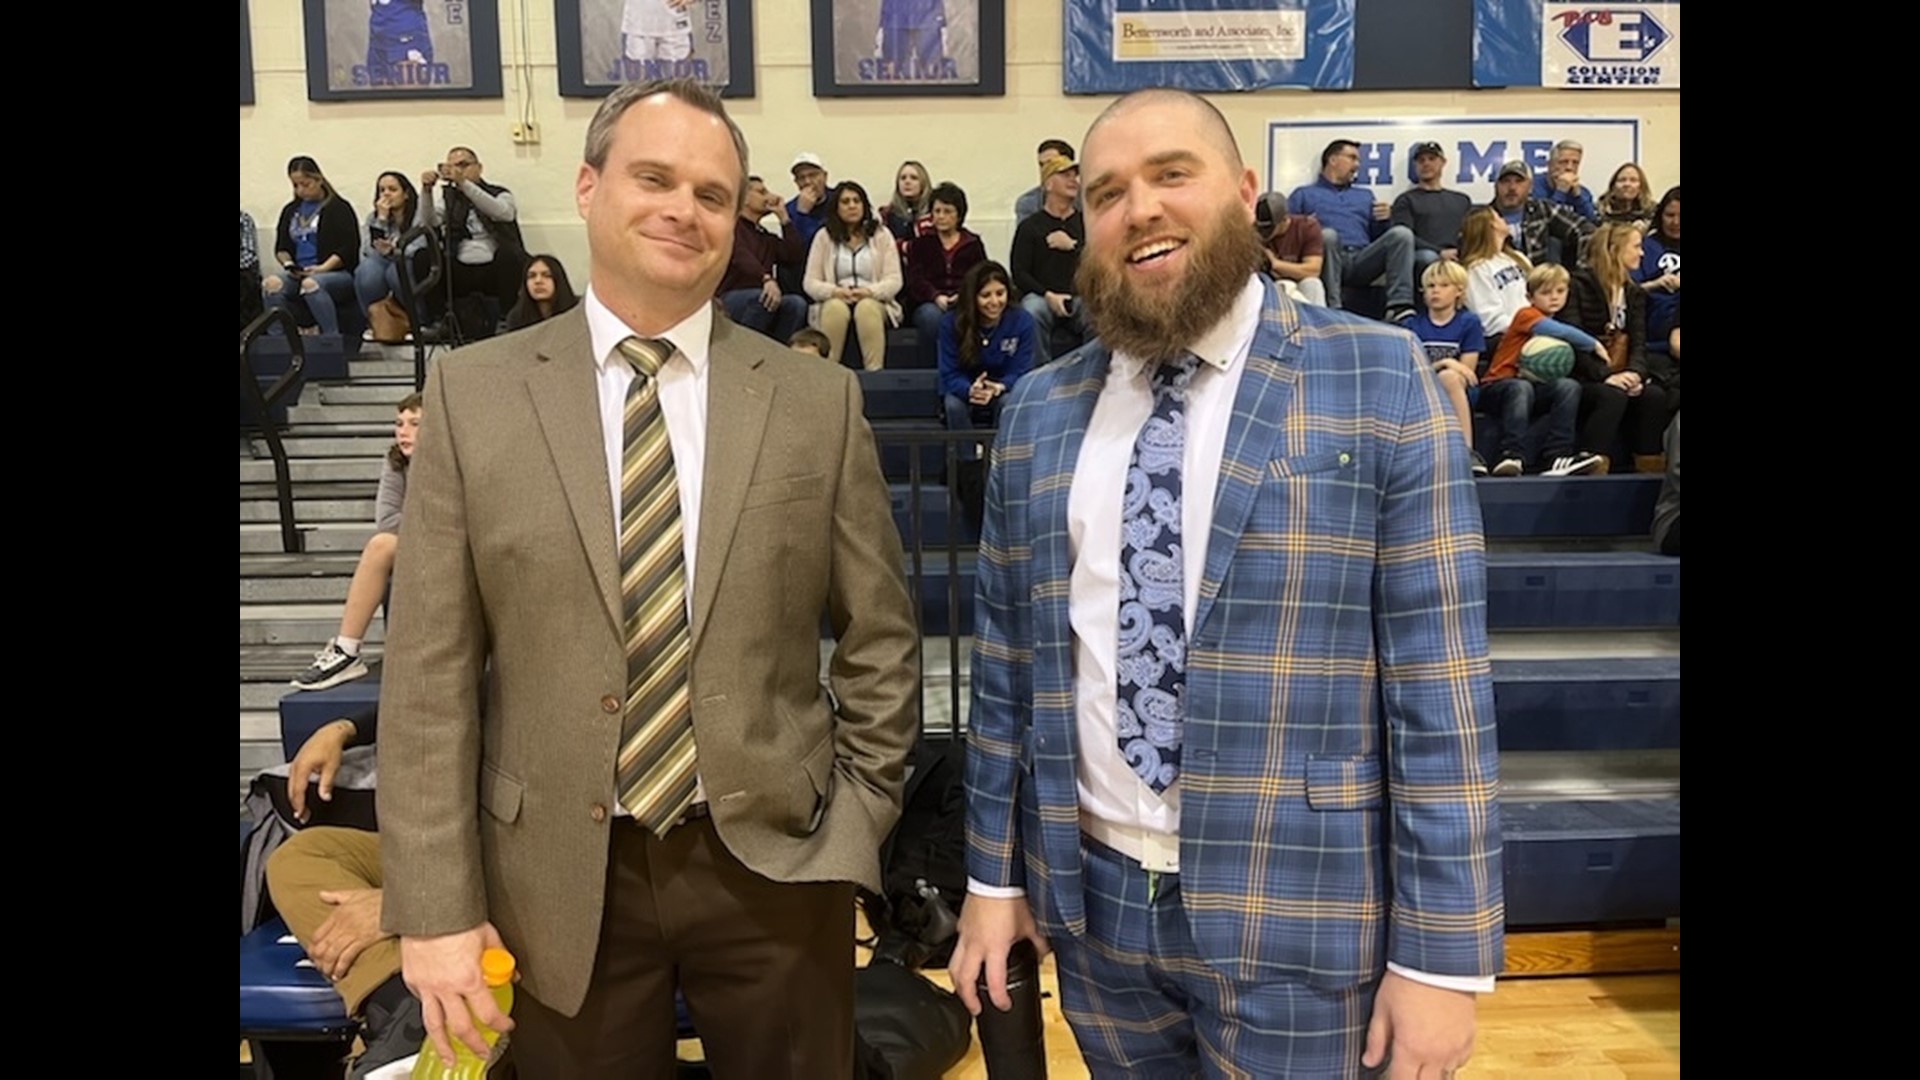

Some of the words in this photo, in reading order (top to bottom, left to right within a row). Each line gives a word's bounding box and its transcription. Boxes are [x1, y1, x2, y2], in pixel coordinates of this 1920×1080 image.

[1194, 26, 1215, 38] and
[351, 63, 452, 87] SENIOR
[607, 58, 710, 81] JUNIOR
[858, 57, 958, 80] SENIOR
[1567, 66, 1661, 76] COLLISION
[1567, 76, 1659, 85] CENTER
